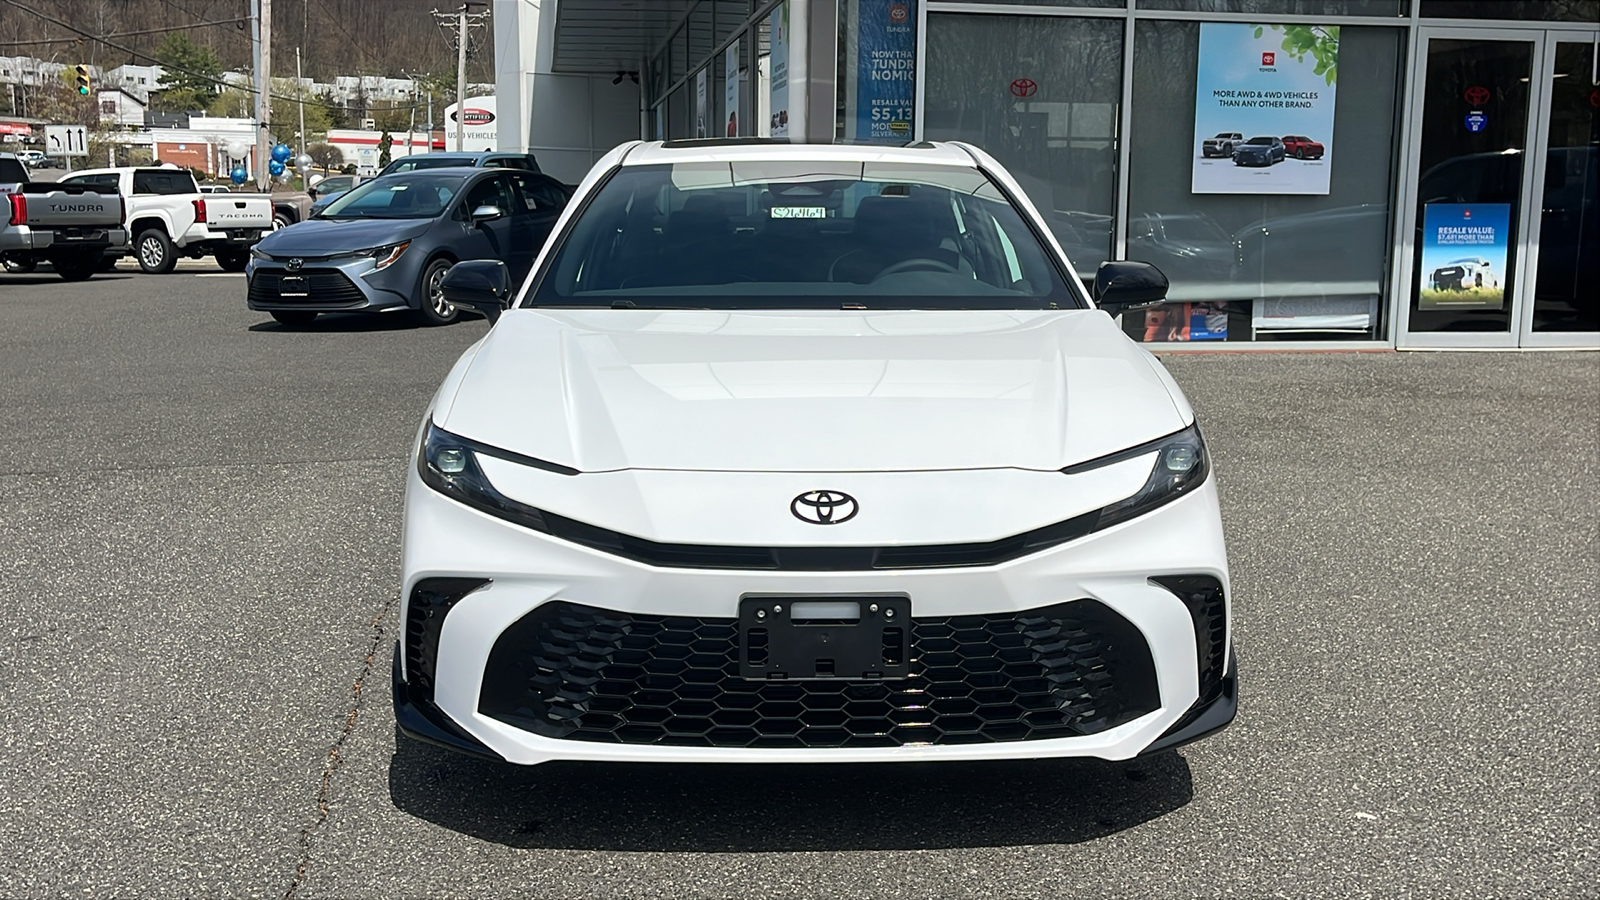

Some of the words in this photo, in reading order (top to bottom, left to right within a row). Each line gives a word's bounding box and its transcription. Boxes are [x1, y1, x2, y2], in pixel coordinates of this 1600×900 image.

[1213, 90, 1236, 98] MORE
[1264, 91, 1282, 99] 4WD
[1285, 101, 1314, 109] BRAND.
[50, 204, 104, 212] TUNDRA
